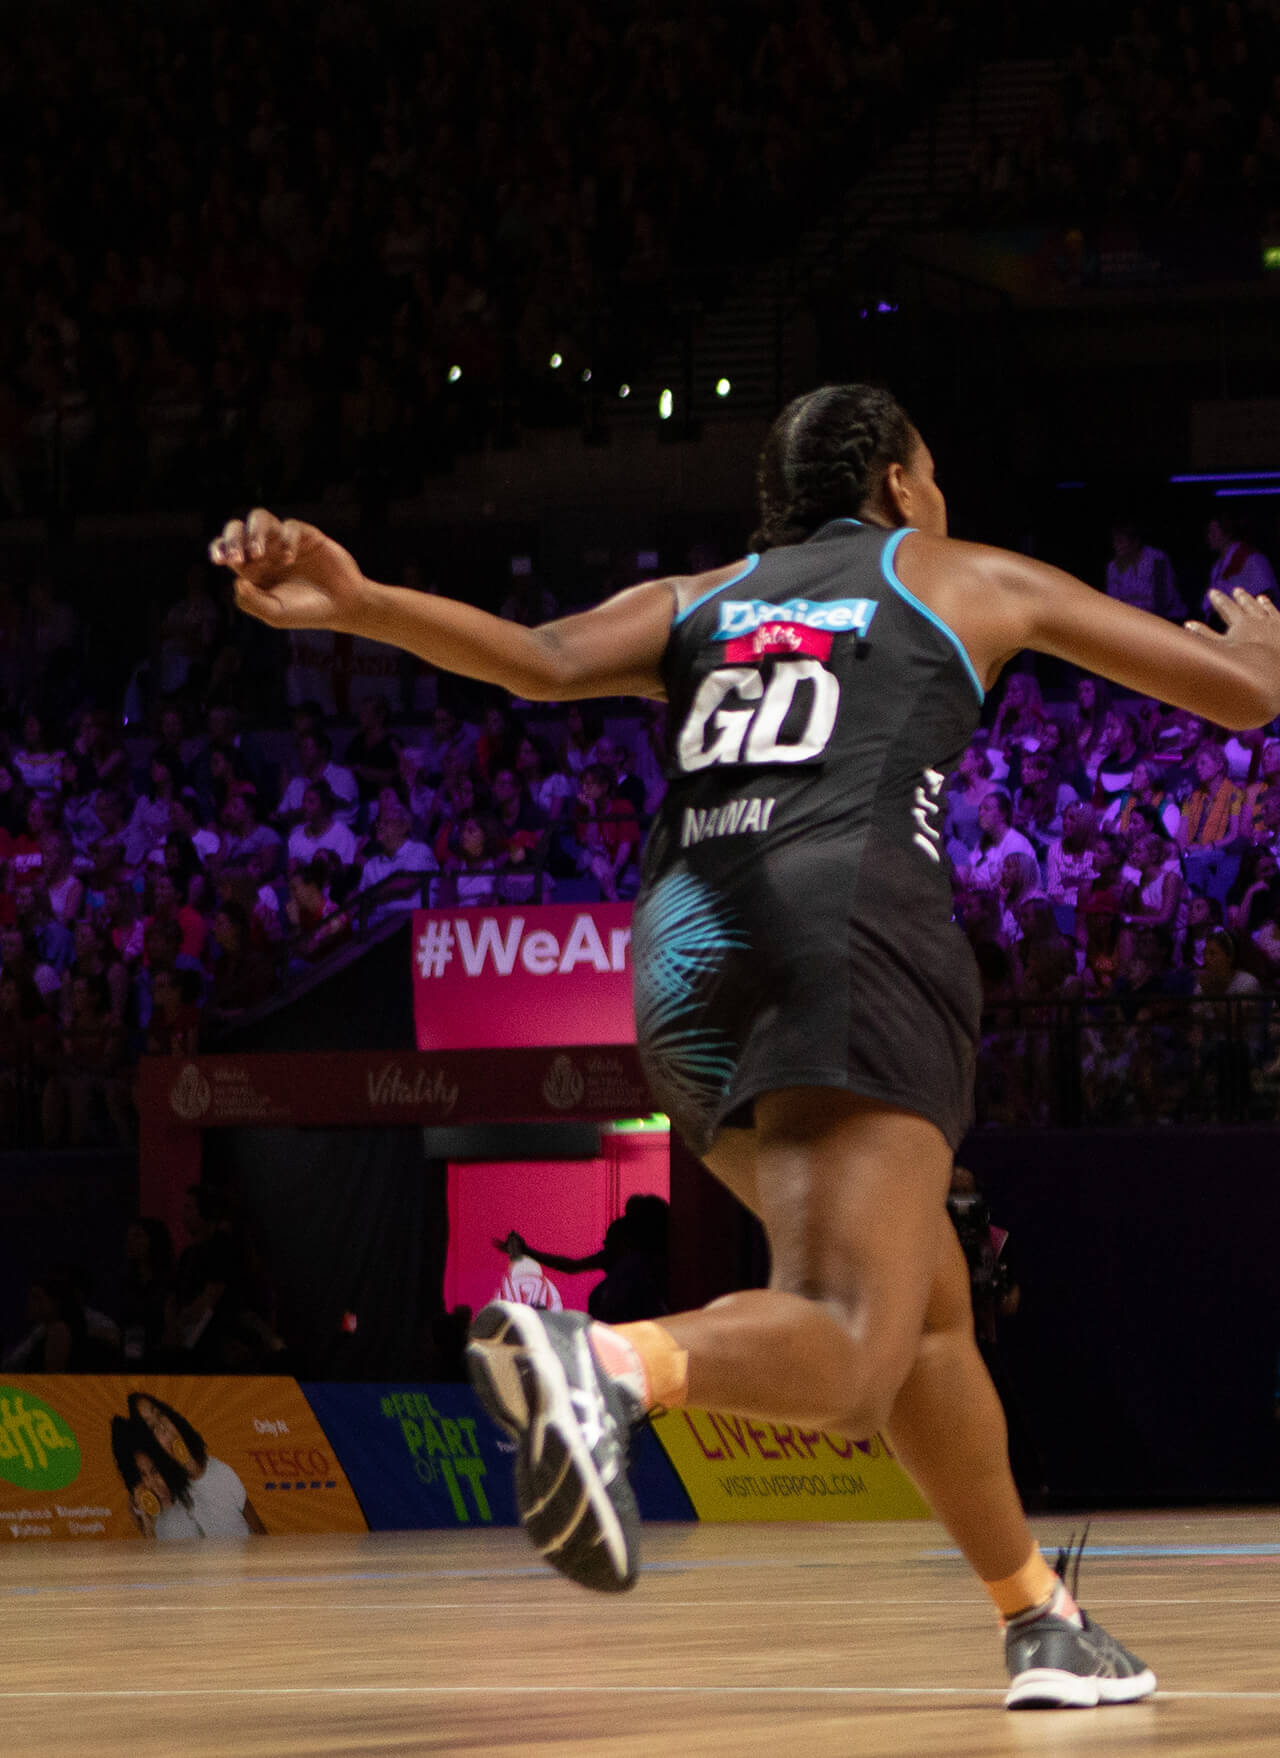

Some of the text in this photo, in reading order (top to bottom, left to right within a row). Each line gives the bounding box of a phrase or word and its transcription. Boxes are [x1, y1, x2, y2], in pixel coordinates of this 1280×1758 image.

[679, 660, 840, 772] GD
[681, 798, 776, 847] NAWAI
[401, 1417, 481, 1456] PART
[249, 1448, 329, 1477] TESCO
[440, 1457, 492, 1521] IT
[719, 1475, 869, 1498] VISITLIVERPOOL.COM
